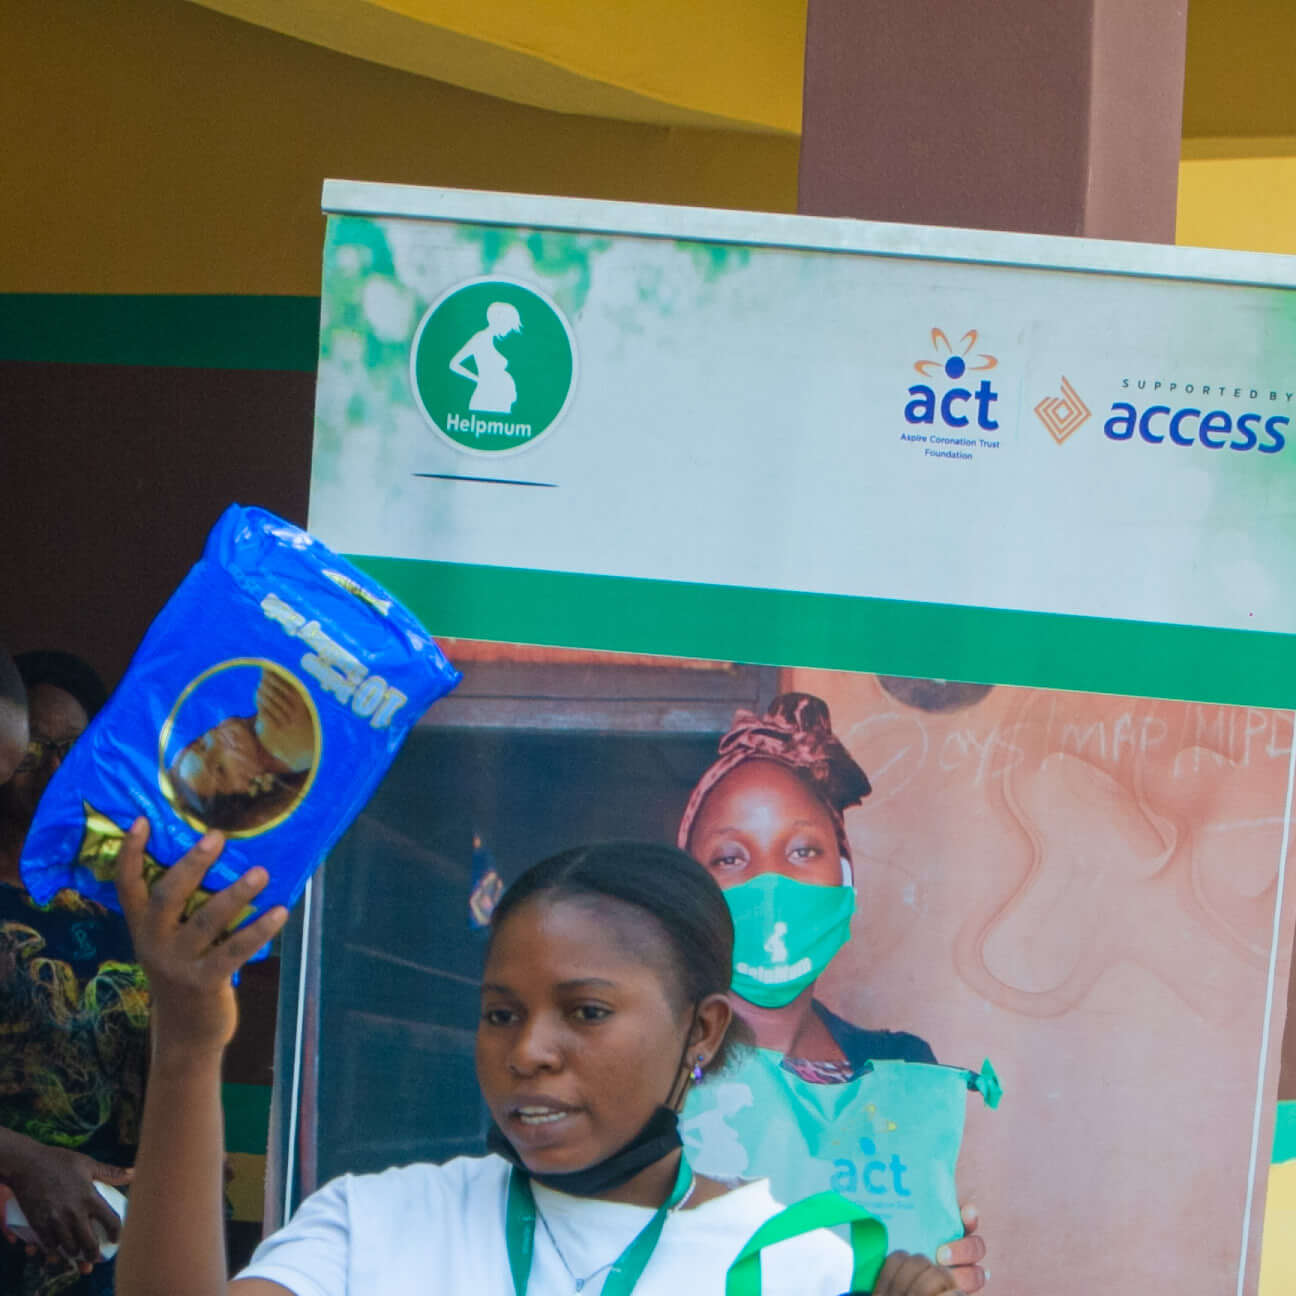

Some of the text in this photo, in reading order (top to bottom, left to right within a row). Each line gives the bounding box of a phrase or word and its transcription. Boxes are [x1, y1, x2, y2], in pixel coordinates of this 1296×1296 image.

[904, 380, 1000, 431] act
[1121, 378, 1294, 403] SUPPORTED BY
[446, 413, 532, 438] Helpmum
[929, 435, 977, 447] Coronation
[979, 439, 1000, 449] Trust
[1104, 402, 1291, 454] access
[924, 448, 973, 460] Foundation
[352, 675, 408, 728] 10
[829, 1154, 912, 1197] act
